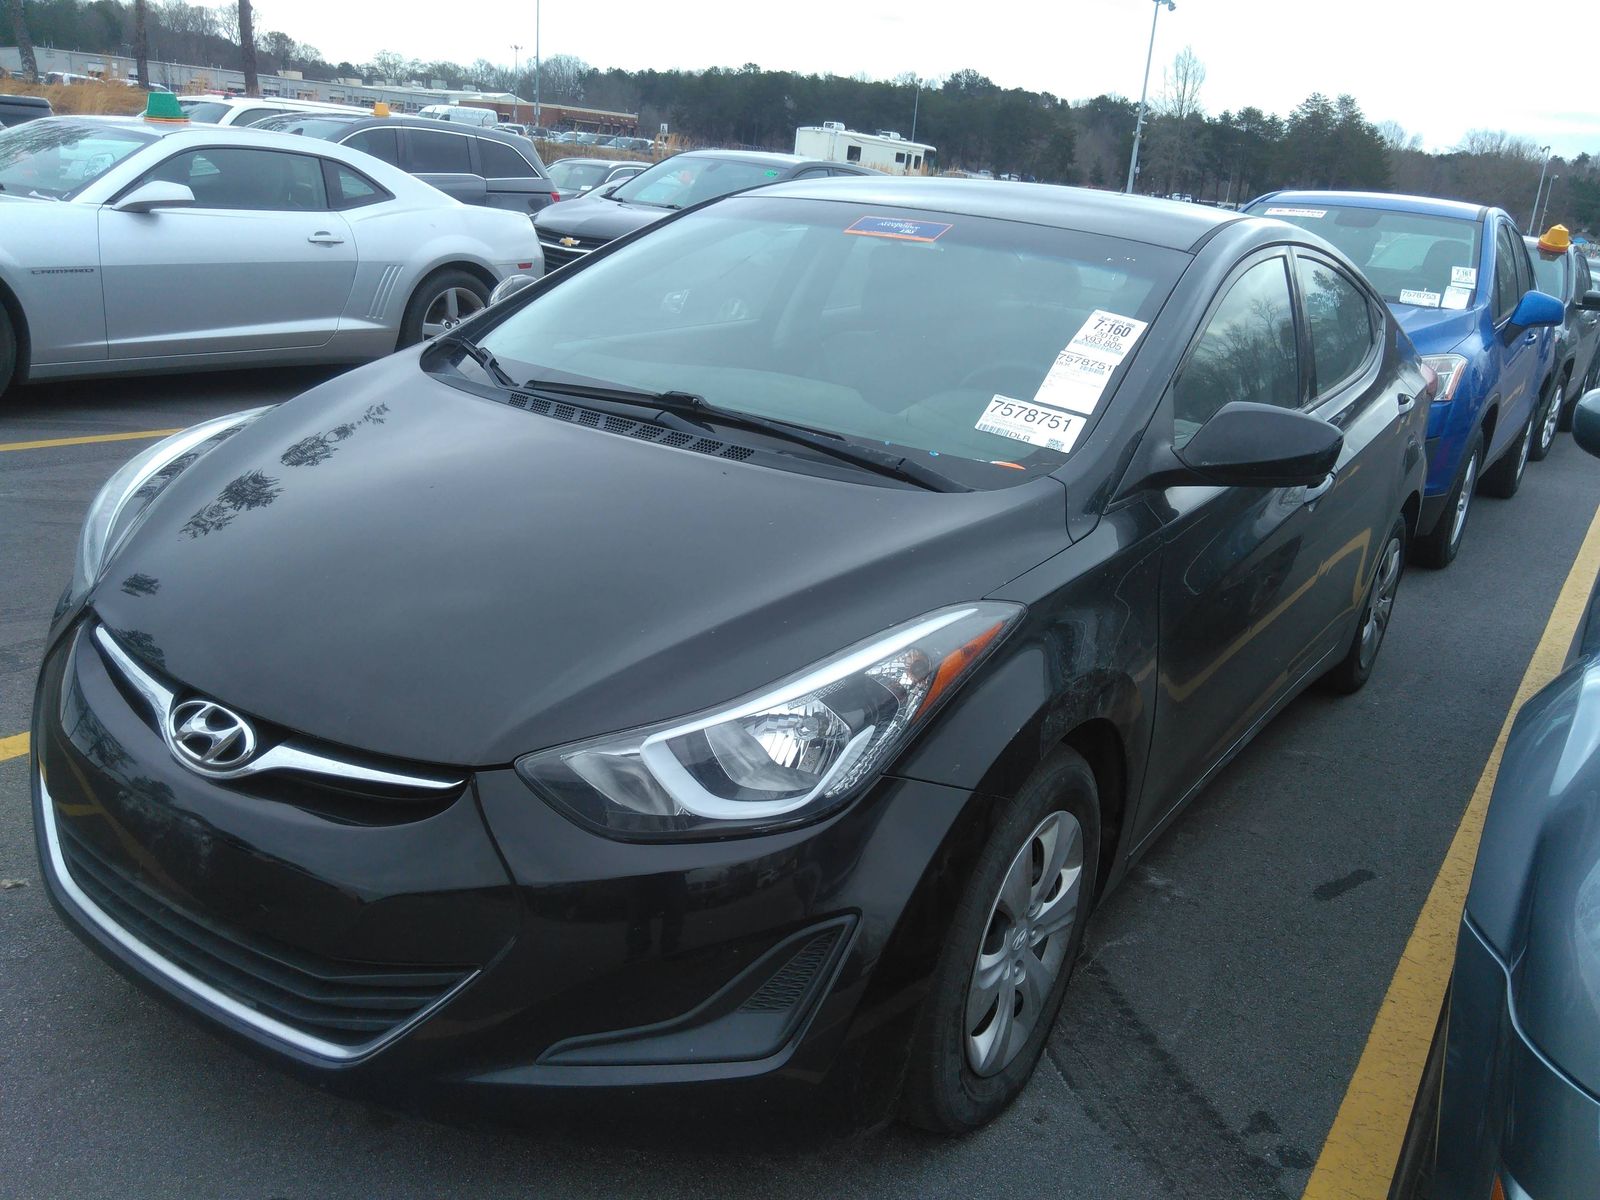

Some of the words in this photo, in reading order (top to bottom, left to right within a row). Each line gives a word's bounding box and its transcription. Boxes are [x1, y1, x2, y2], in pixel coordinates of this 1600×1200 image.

[1095, 331, 1120, 342] 2016
[1058, 353, 1112, 371] 7578751
[990, 400, 1072, 432] 7578751
[1009, 431, 1030, 442] DLR
